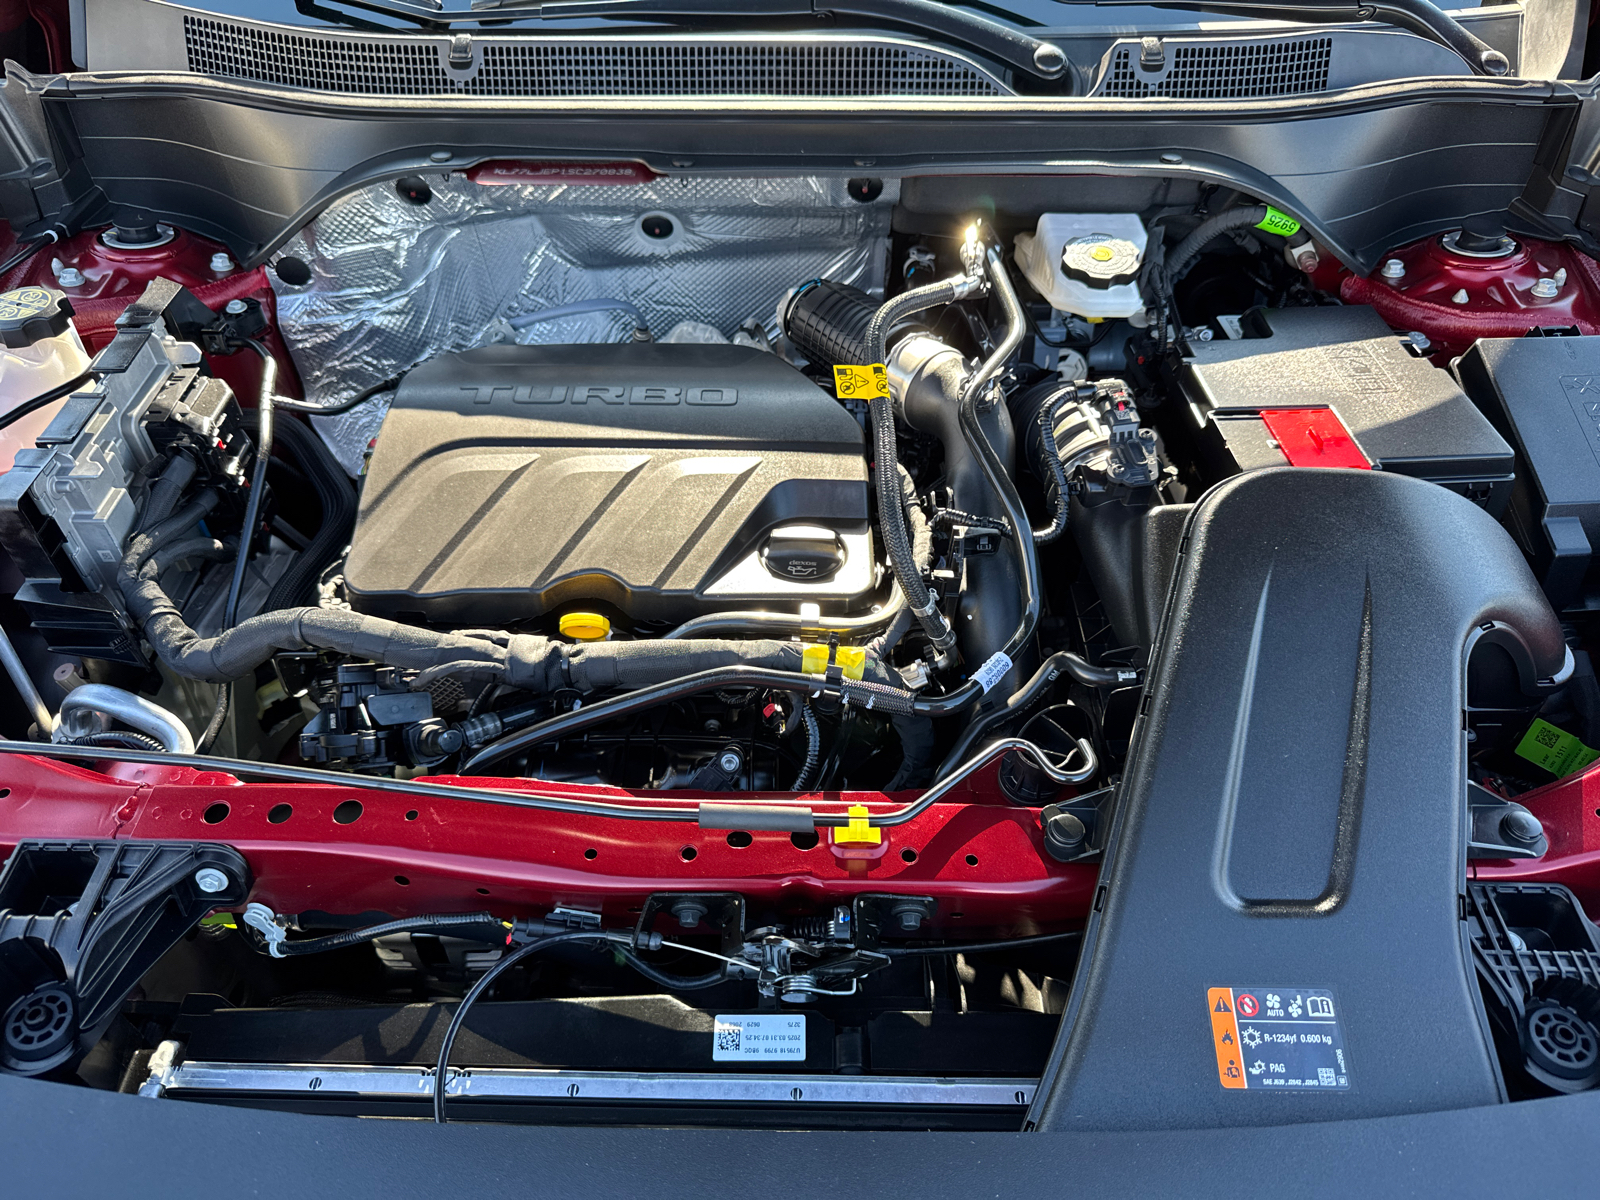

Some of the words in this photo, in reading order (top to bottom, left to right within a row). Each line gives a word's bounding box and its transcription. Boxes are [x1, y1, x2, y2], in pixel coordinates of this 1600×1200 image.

[493, 168, 633, 176] KL77LJEP1SC270838
[1266, 214, 1297, 233] 5925
[459, 385, 739, 406] TURBO
[1554, 745, 1568, 759] 1511
[1540, 754, 1550, 765] Lear
[1266, 1009, 1285, 1017] AUTO
[1263, 1033, 1297, 1045] R-1234yf
[1300, 1034, 1321, 1044] 0.600
[1321, 1034, 1332, 1045] kg
[1269, 1062, 1286, 1073] PAG
